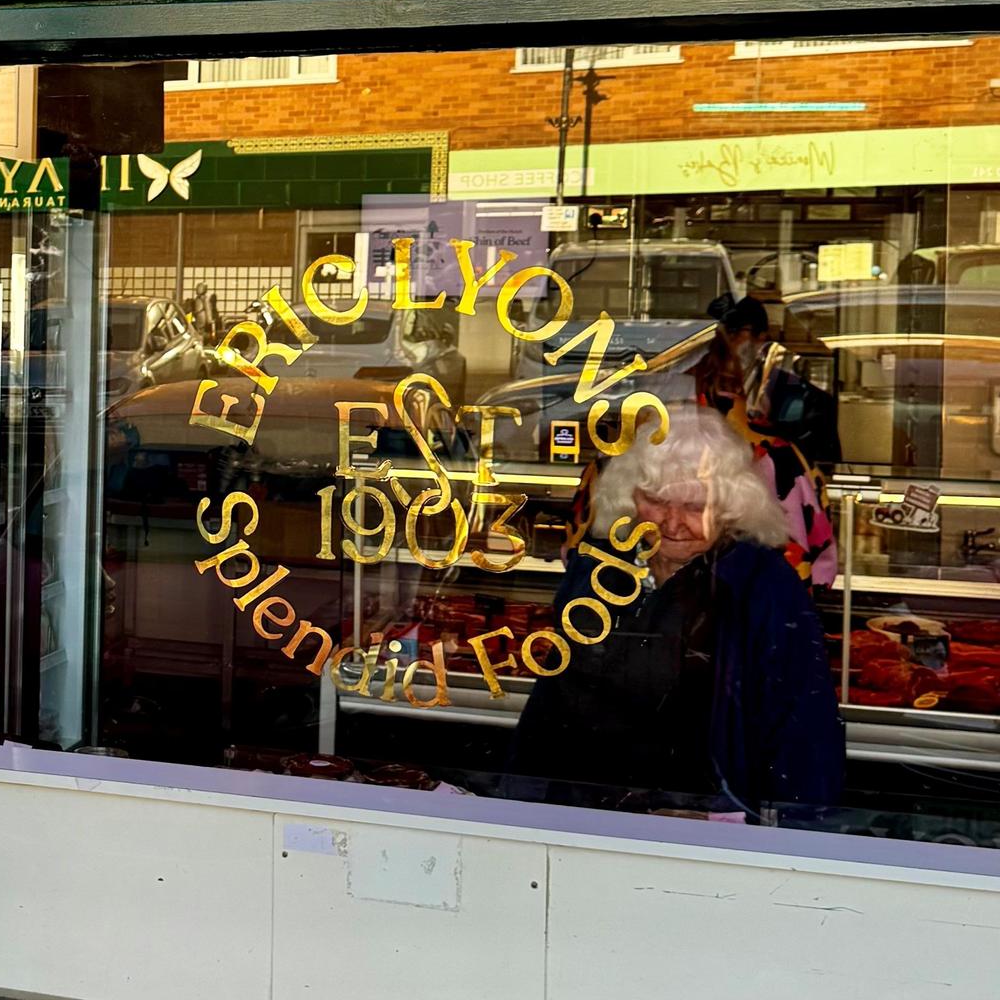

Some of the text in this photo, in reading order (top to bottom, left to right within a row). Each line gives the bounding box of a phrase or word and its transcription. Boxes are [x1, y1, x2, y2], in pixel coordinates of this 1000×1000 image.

[188, 237, 671, 458] ERIC LYONS
[315, 483, 529, 574] 1903
[334, 372, 523, 516] EST
[194, 490, 662, 709] Splendid Foods
